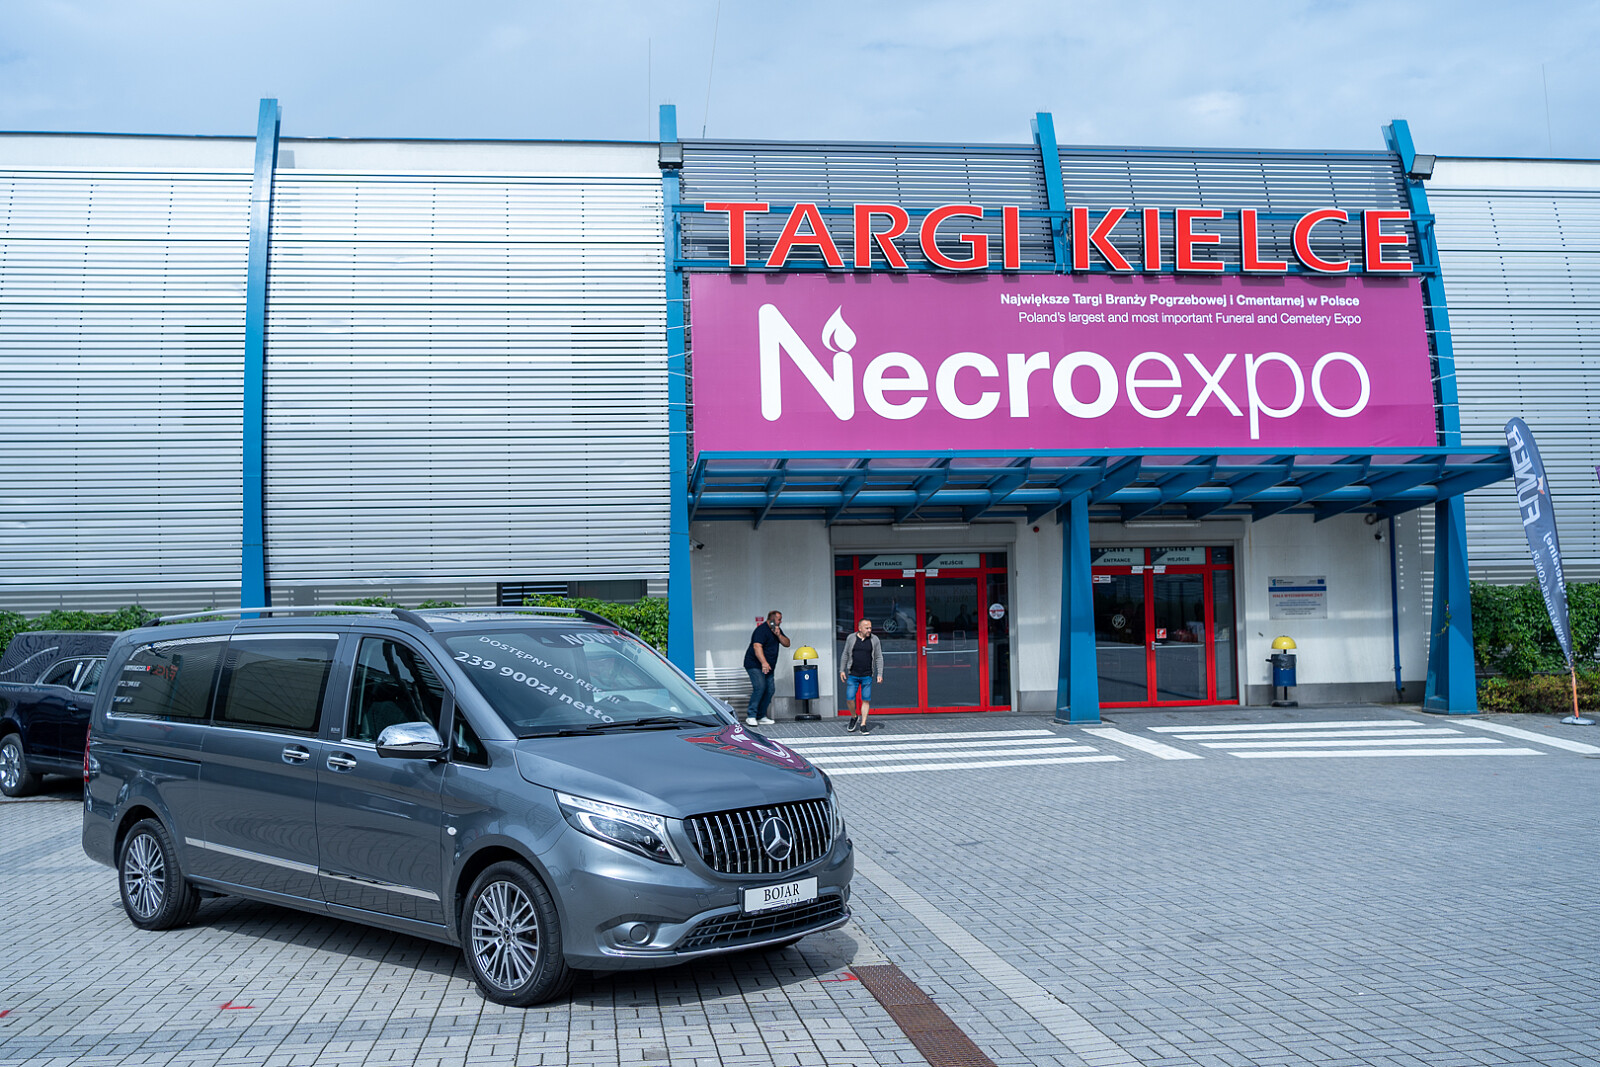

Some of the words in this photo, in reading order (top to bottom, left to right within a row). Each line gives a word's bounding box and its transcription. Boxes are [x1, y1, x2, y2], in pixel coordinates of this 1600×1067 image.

[703, 202, 1021, 270] TARGI
[1071, 206, 1415, 273] KIELCE
[1000, 293, 1070, 306] Największe
[1072, 293, 1103, 306] Targi
[1105, 292, 1147, 307] Branży
[1150, 294, 1227, 308] Pogrzebowej
[1230, 295, 1234, 306] i
[1236, 295, 1305, 308] Cmentarnej
[1307, 297, 1318, 306] w
[1321, 295, 1360, 306] Polsce
[1018, 311, 1066, 323] Poland's
[1069, 312, 1105, 325] largest
[1108, 312, 1129, 323] and
[1131, 312, 1159, 323] most
[1161, 312, 1213, 325] important
[1216, 313, 1254, 324] Funeral
[1257, 313, 1278, 324] and
[1280, 313, 1331, 326] Cemetery
[1334, 313, 1362, 326] Expo
[758, 303, 1371, 440] Necroexpo
[560, 633, 621, 646] NOWY
[479, 636, 552, 669] DOSTĘPNY
[553, 667, 574, 680] OD
[454, 651, 496, 669] 239
[499, 666, 558, 696] 900zł
[559, 693, 615, 723] netto
[763, 883, 800, 902] BOJAR
